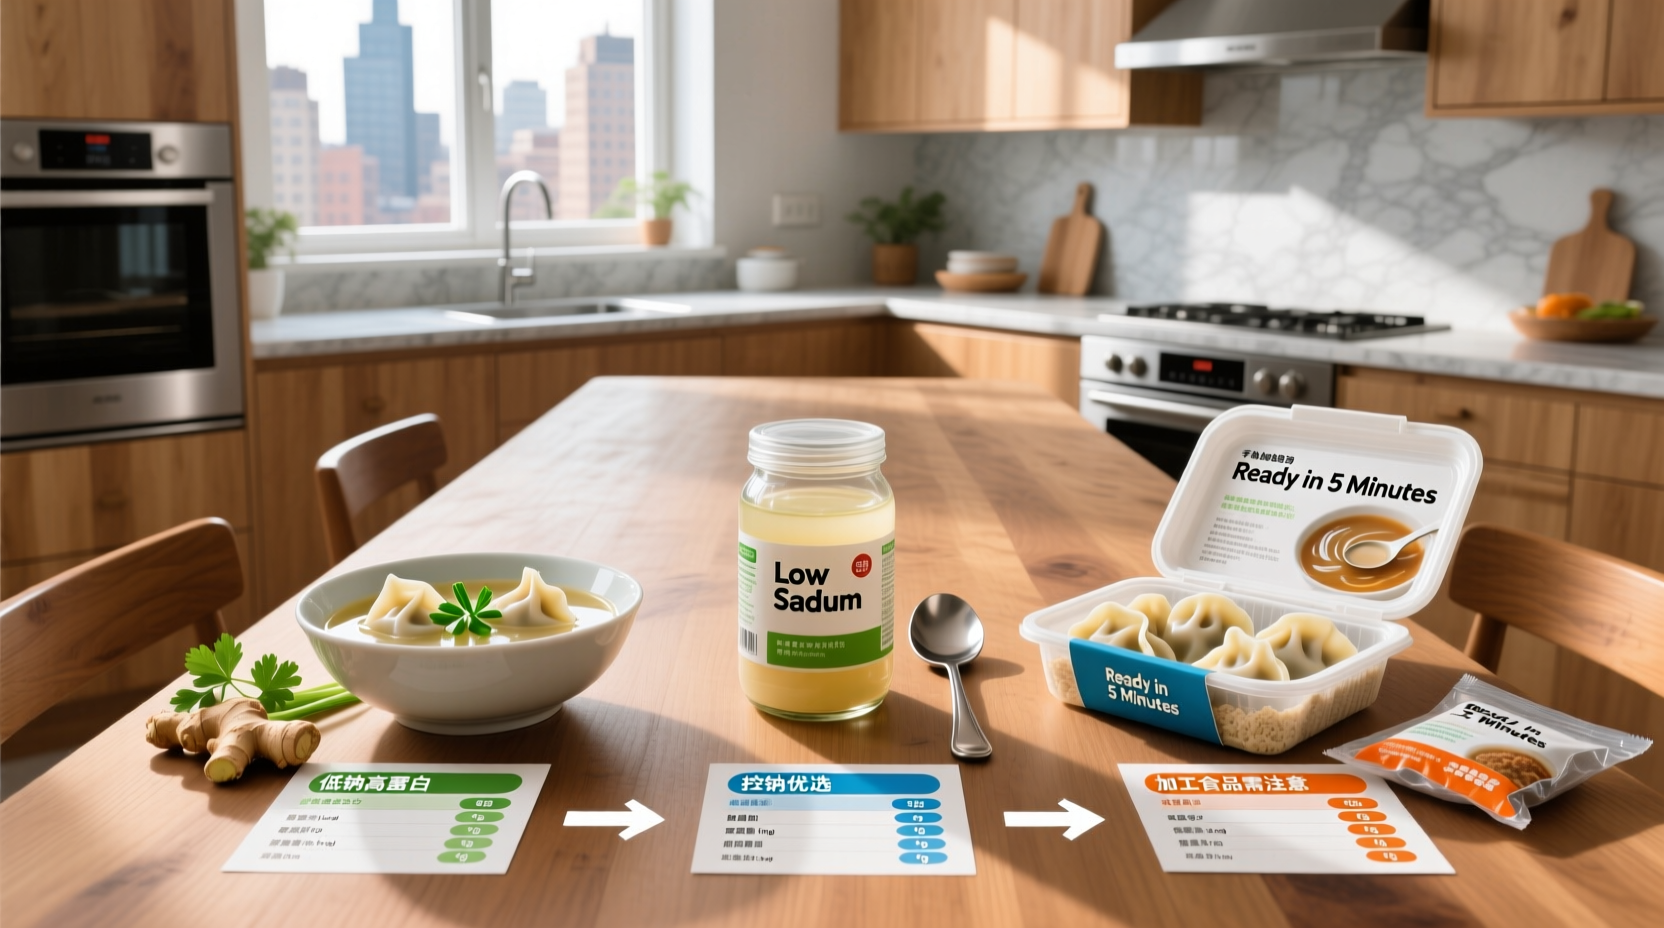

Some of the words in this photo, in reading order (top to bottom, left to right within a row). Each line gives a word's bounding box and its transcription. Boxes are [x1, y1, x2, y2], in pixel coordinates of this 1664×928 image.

[1232, 461, 1300, 491] Ready
[1302, 469, 1324, 489] in
[1327, 472, 1345, 493] 5
[1346, 474, 1438, 505] Minutes
[774, 561, 830, 586] Low
[773, 587, 862, 613] Sadum
[1104, 666, 1151, 694] Ready
[1154, 678, 1169, 697] in
[1108, 684, 1117, 700] 5
[1155, 774, 1309, 792] 加工食品需注意
